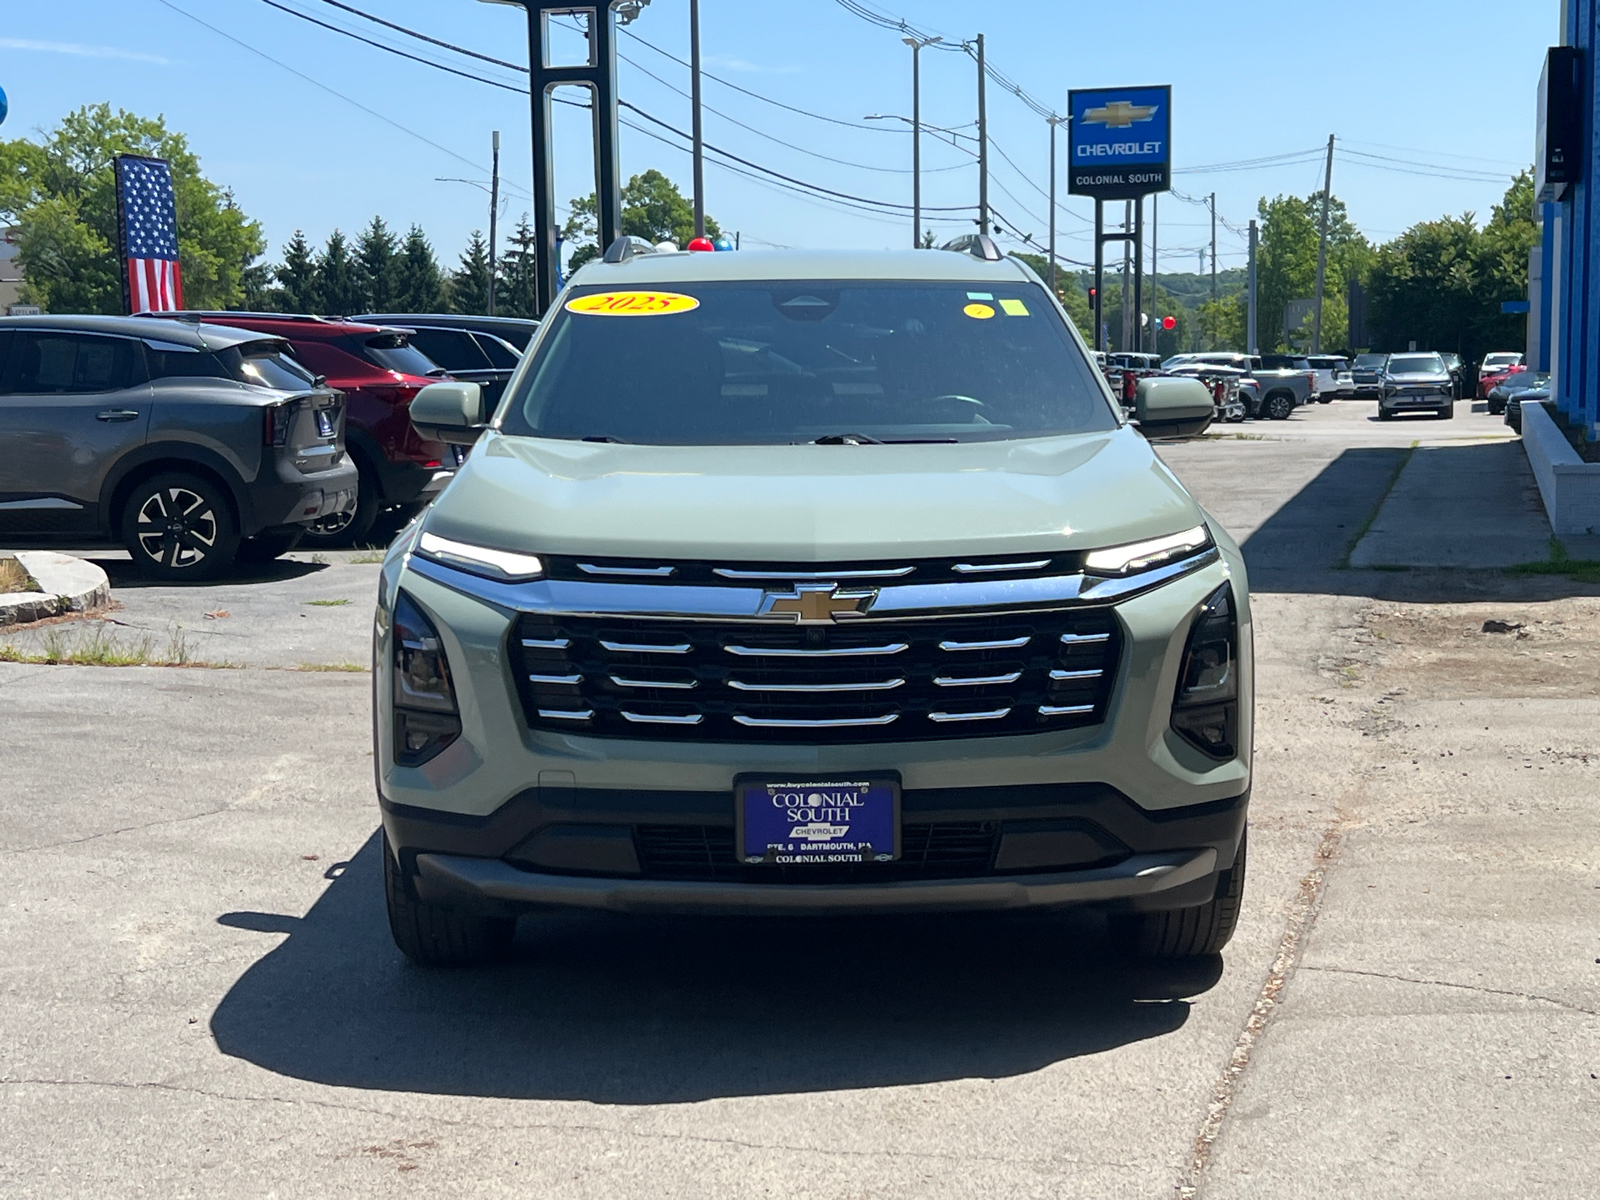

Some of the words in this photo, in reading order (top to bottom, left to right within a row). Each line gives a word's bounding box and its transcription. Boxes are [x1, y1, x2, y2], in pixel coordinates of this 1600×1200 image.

[1077, 141, 1162, 157] CHEVROLET
[1076, 175, 1126, 186] COLONIAL
[1128, 173, 1162, 184] SOUTH
[584, 296, 680, 311] 2025
[772, 792, 865, 808] COLONIAL
[787, 807, 850, 822] SOUTH
[795, 828, 844, 836] CHEVROLET
[788, 843, 794, 851] 6
[800, 842, 857, 851] DARTMOUTH,
[775, 855, 827, 863] COLONIAL
[828, 854, 862, 862] SOUTH
